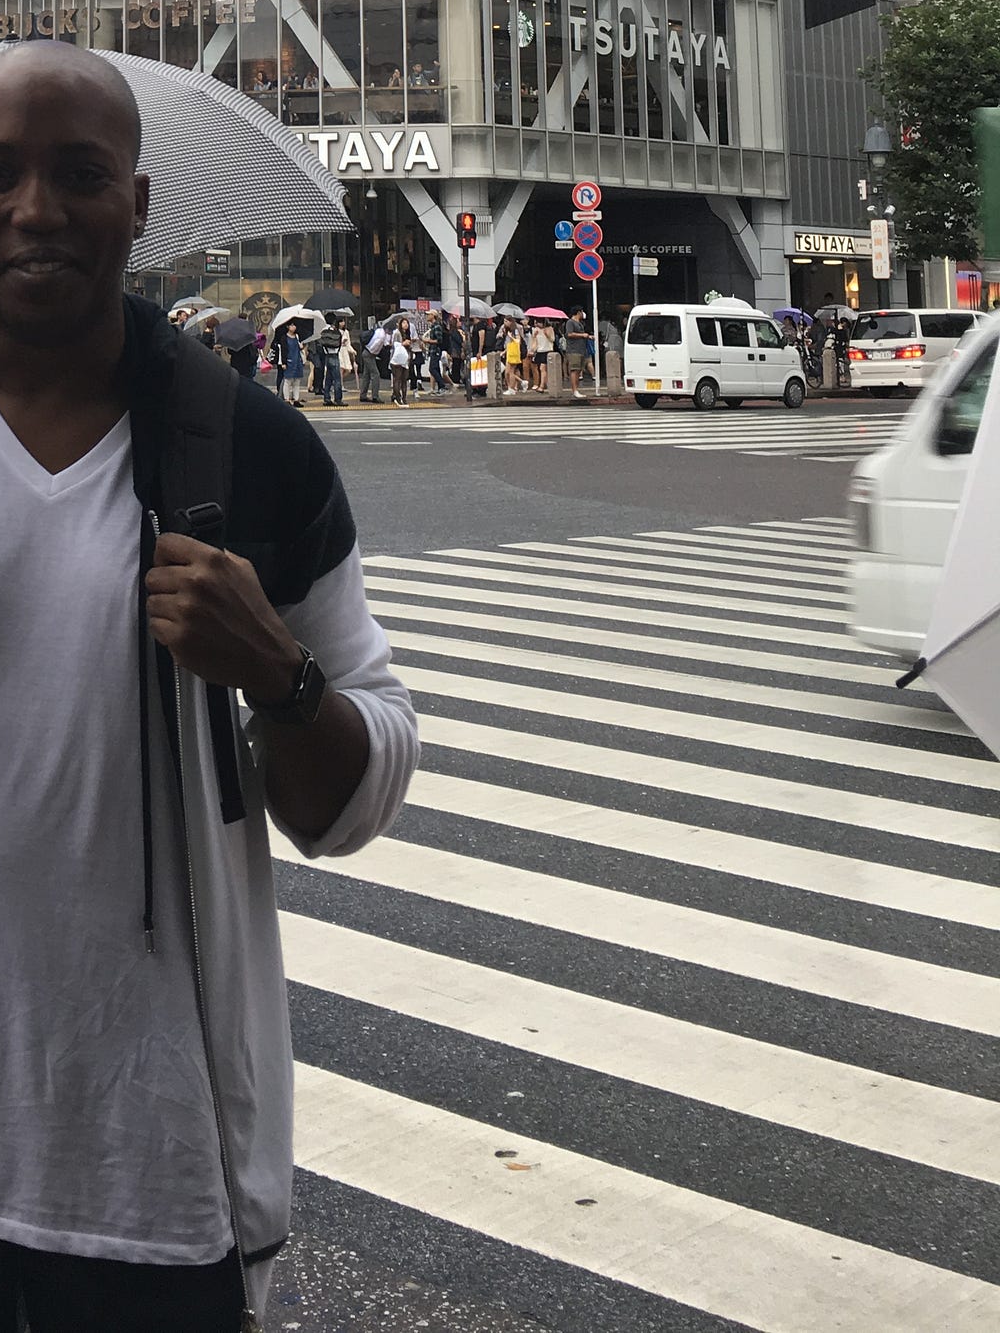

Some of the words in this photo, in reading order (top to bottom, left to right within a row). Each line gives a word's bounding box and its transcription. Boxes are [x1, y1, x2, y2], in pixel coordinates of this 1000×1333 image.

[569, 16, 730, 70] TSUTAYA
[296, 131, 440, 171] TAYA
[650, 245, 692, 254] COFFEE
[796, 234, 855, 253] TSUTAYA
